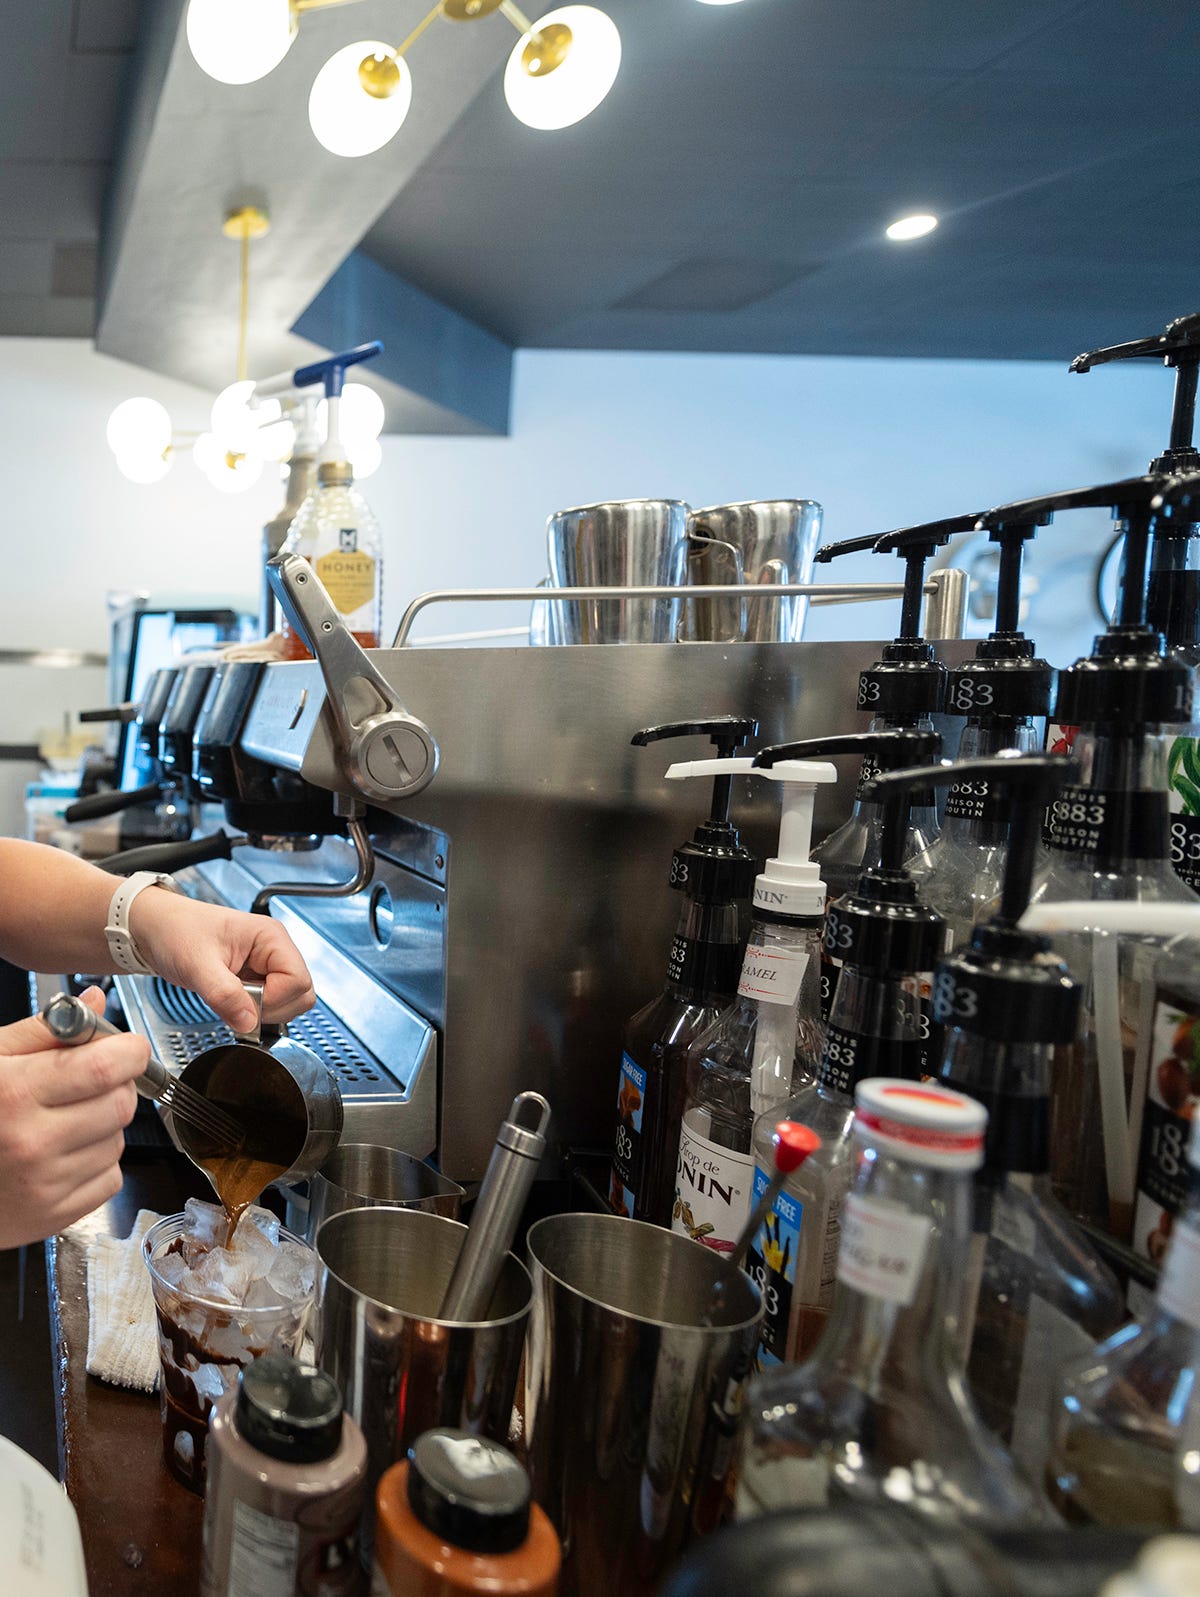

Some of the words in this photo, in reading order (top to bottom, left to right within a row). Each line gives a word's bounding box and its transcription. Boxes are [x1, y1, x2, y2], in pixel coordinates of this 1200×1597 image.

[323, 562, 370, 573] HONEY
[754, 888, 784, 905] NIN
[703, 1161, 720, 1176] de
[677, 1153, 734, 1207] NIN
[775, 1195, 797, 1223] FREE
